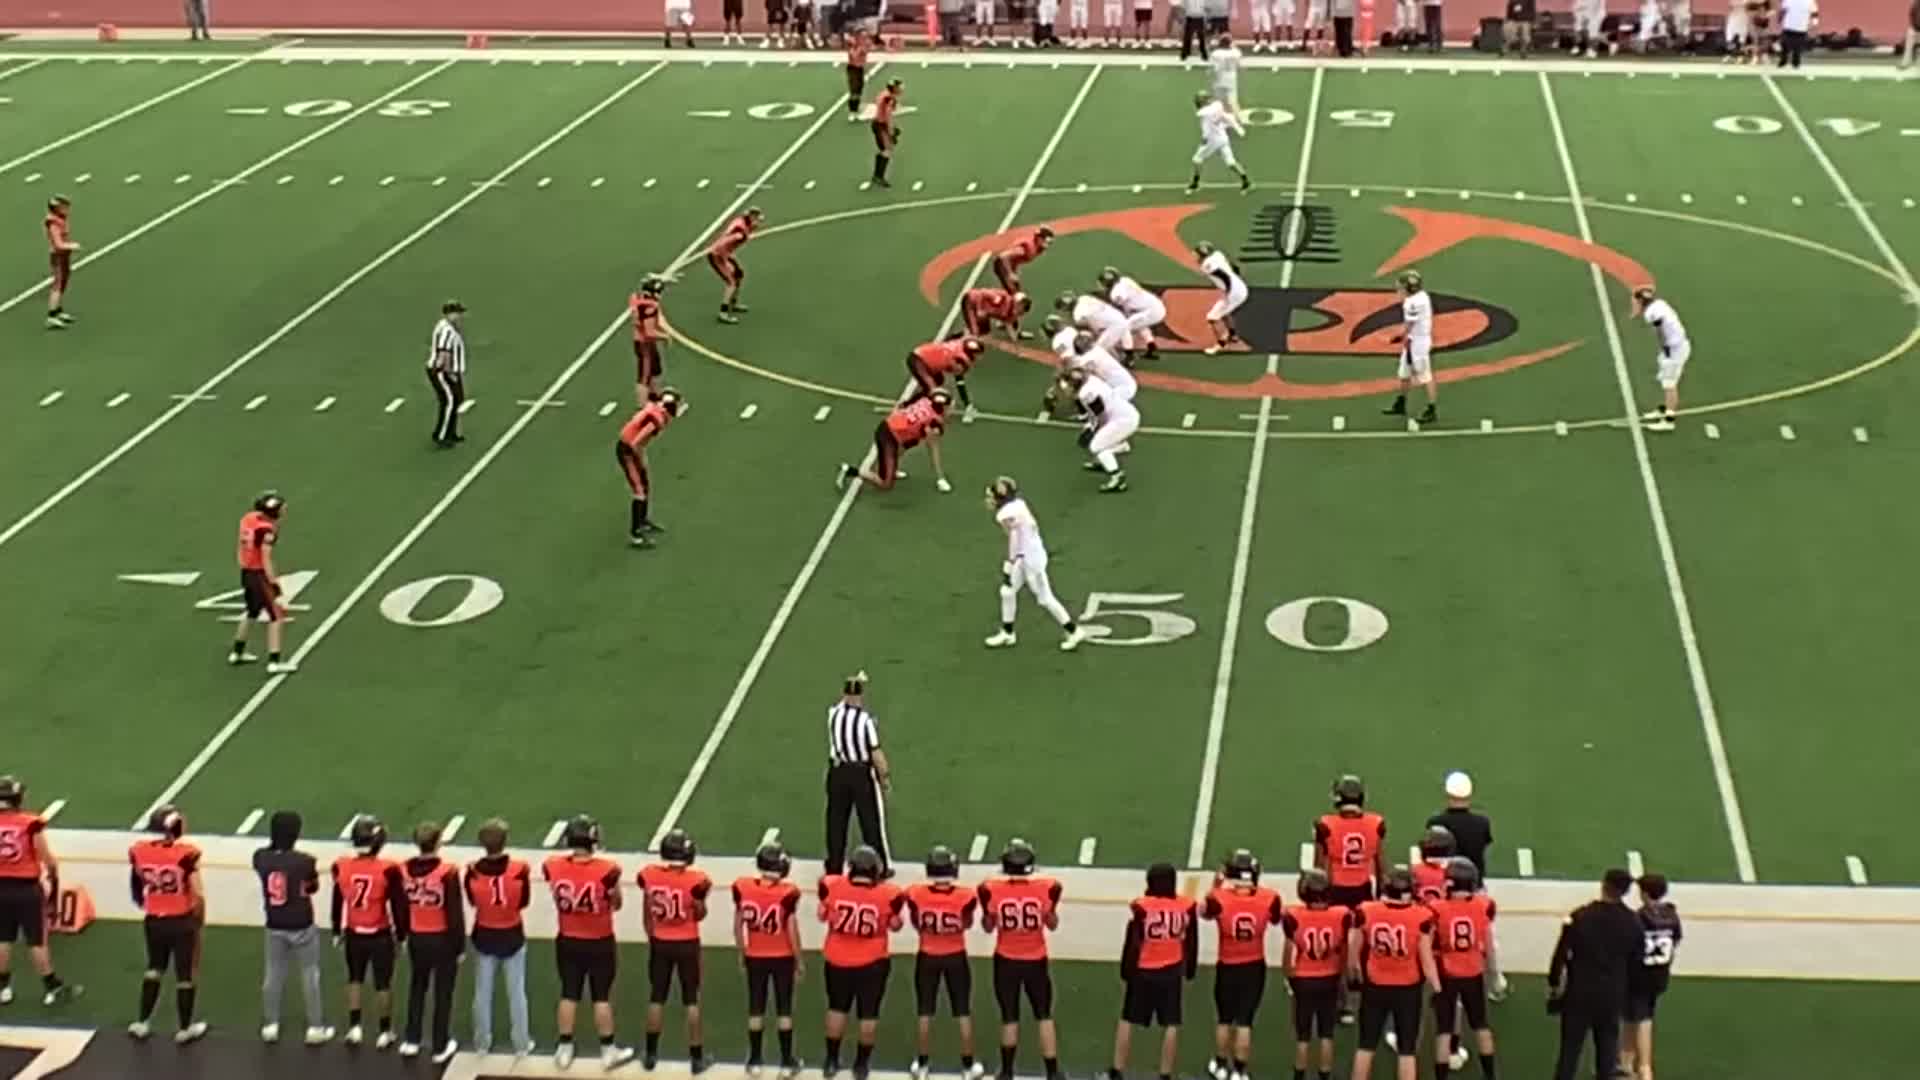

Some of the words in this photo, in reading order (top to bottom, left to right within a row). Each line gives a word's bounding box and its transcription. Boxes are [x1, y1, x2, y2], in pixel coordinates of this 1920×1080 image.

[1342, 832, 1366, 868] 2
[267, 872, 288, 906] 9
[351, 873, 374, 910] 7
[488, 874, 507, 908] 1
[554, 879, 601, 914] 64
[834, 901, 879, 939] 76
[1000, 897, 1043, 932] 66
[1232, 911, 1257, 943] 6
[1450, 915, 1476, 952] 8
